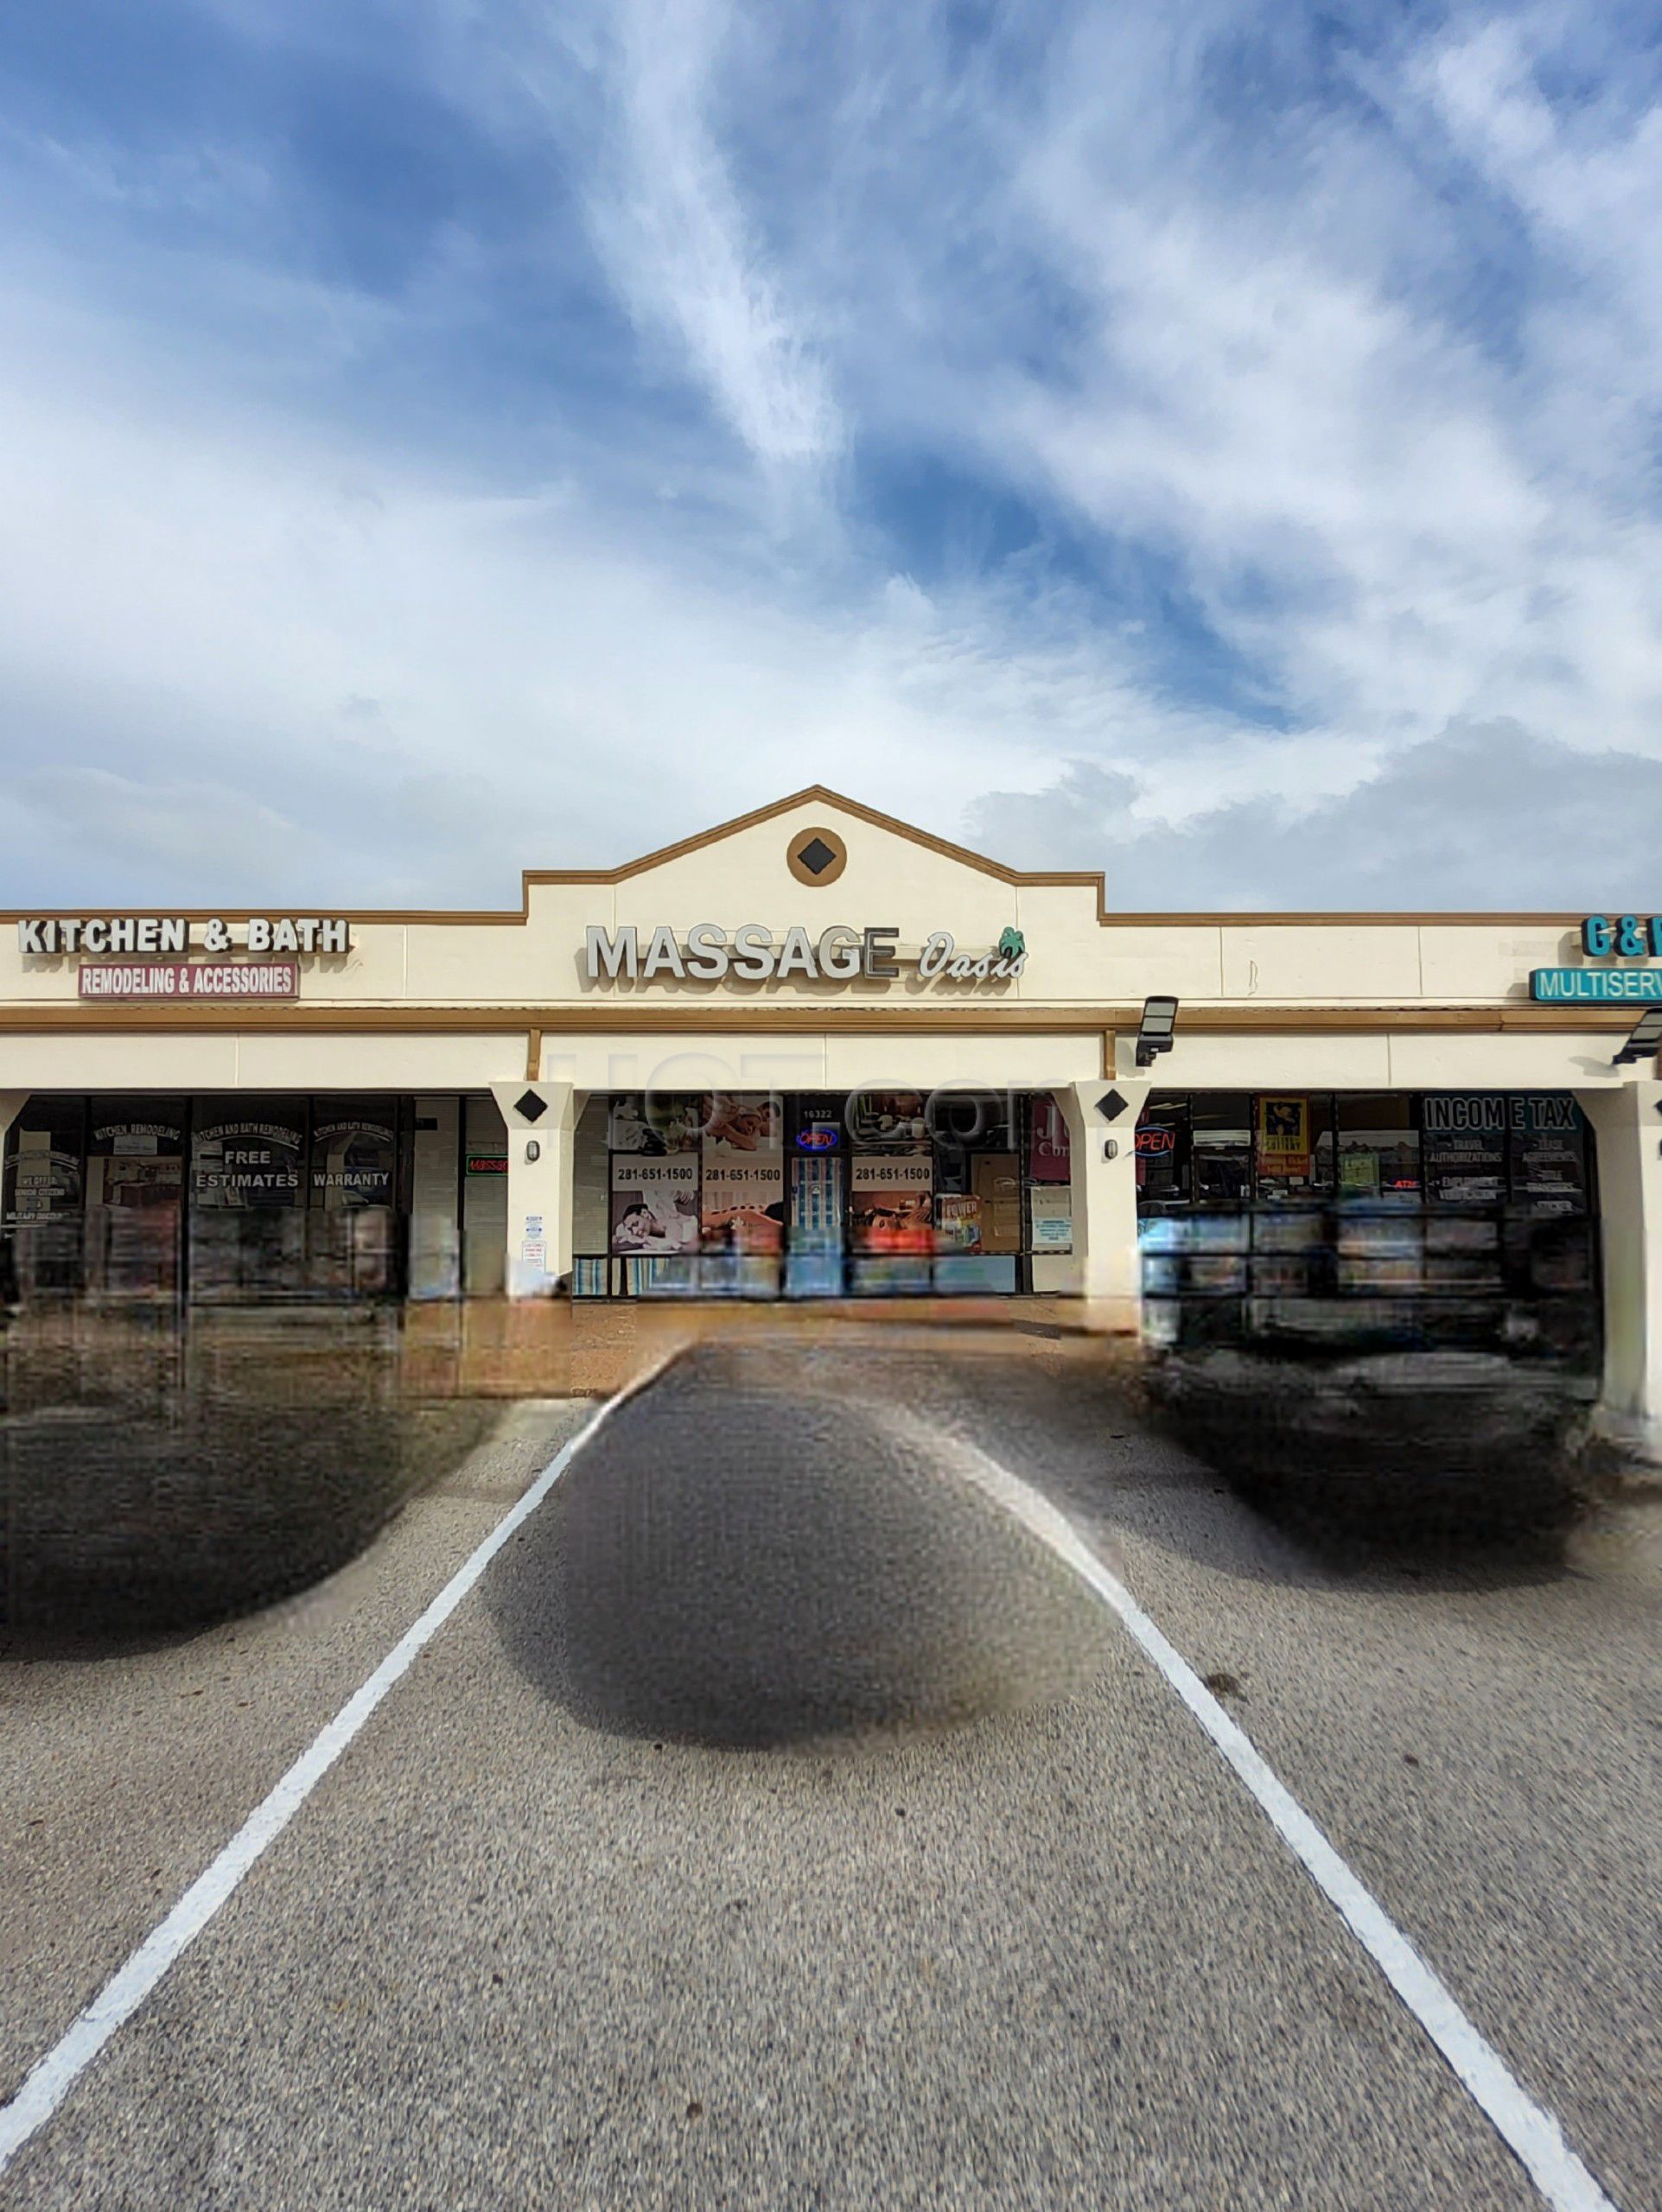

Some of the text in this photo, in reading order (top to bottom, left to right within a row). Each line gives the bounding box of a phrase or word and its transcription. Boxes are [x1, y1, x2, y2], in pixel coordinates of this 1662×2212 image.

[18, 918, 349, 952] KITCHEN & BATH
[586, 923, 1028, 980] MASSAGE Oasis
[81, 967, 292, 994] REMODELING & ACCESSORIES
[804, 1110, 832, 1119] 16322
[1424, 1096, 1577, 1131] INCOME TAX
[800, 1132, 834, 1147] OPEN
[224, 1150, 271, 1165] FREE
[195, 1174, 300, 1187] ESTIMATES
[313, 1173, 389, 1186] WARRANTY
[618, 1168, 692, 1179] 281-651-1500
[705, 1169, 780, 1181] 281-651-1500
[856, 1168, 931, 1180] 281-651-1500
